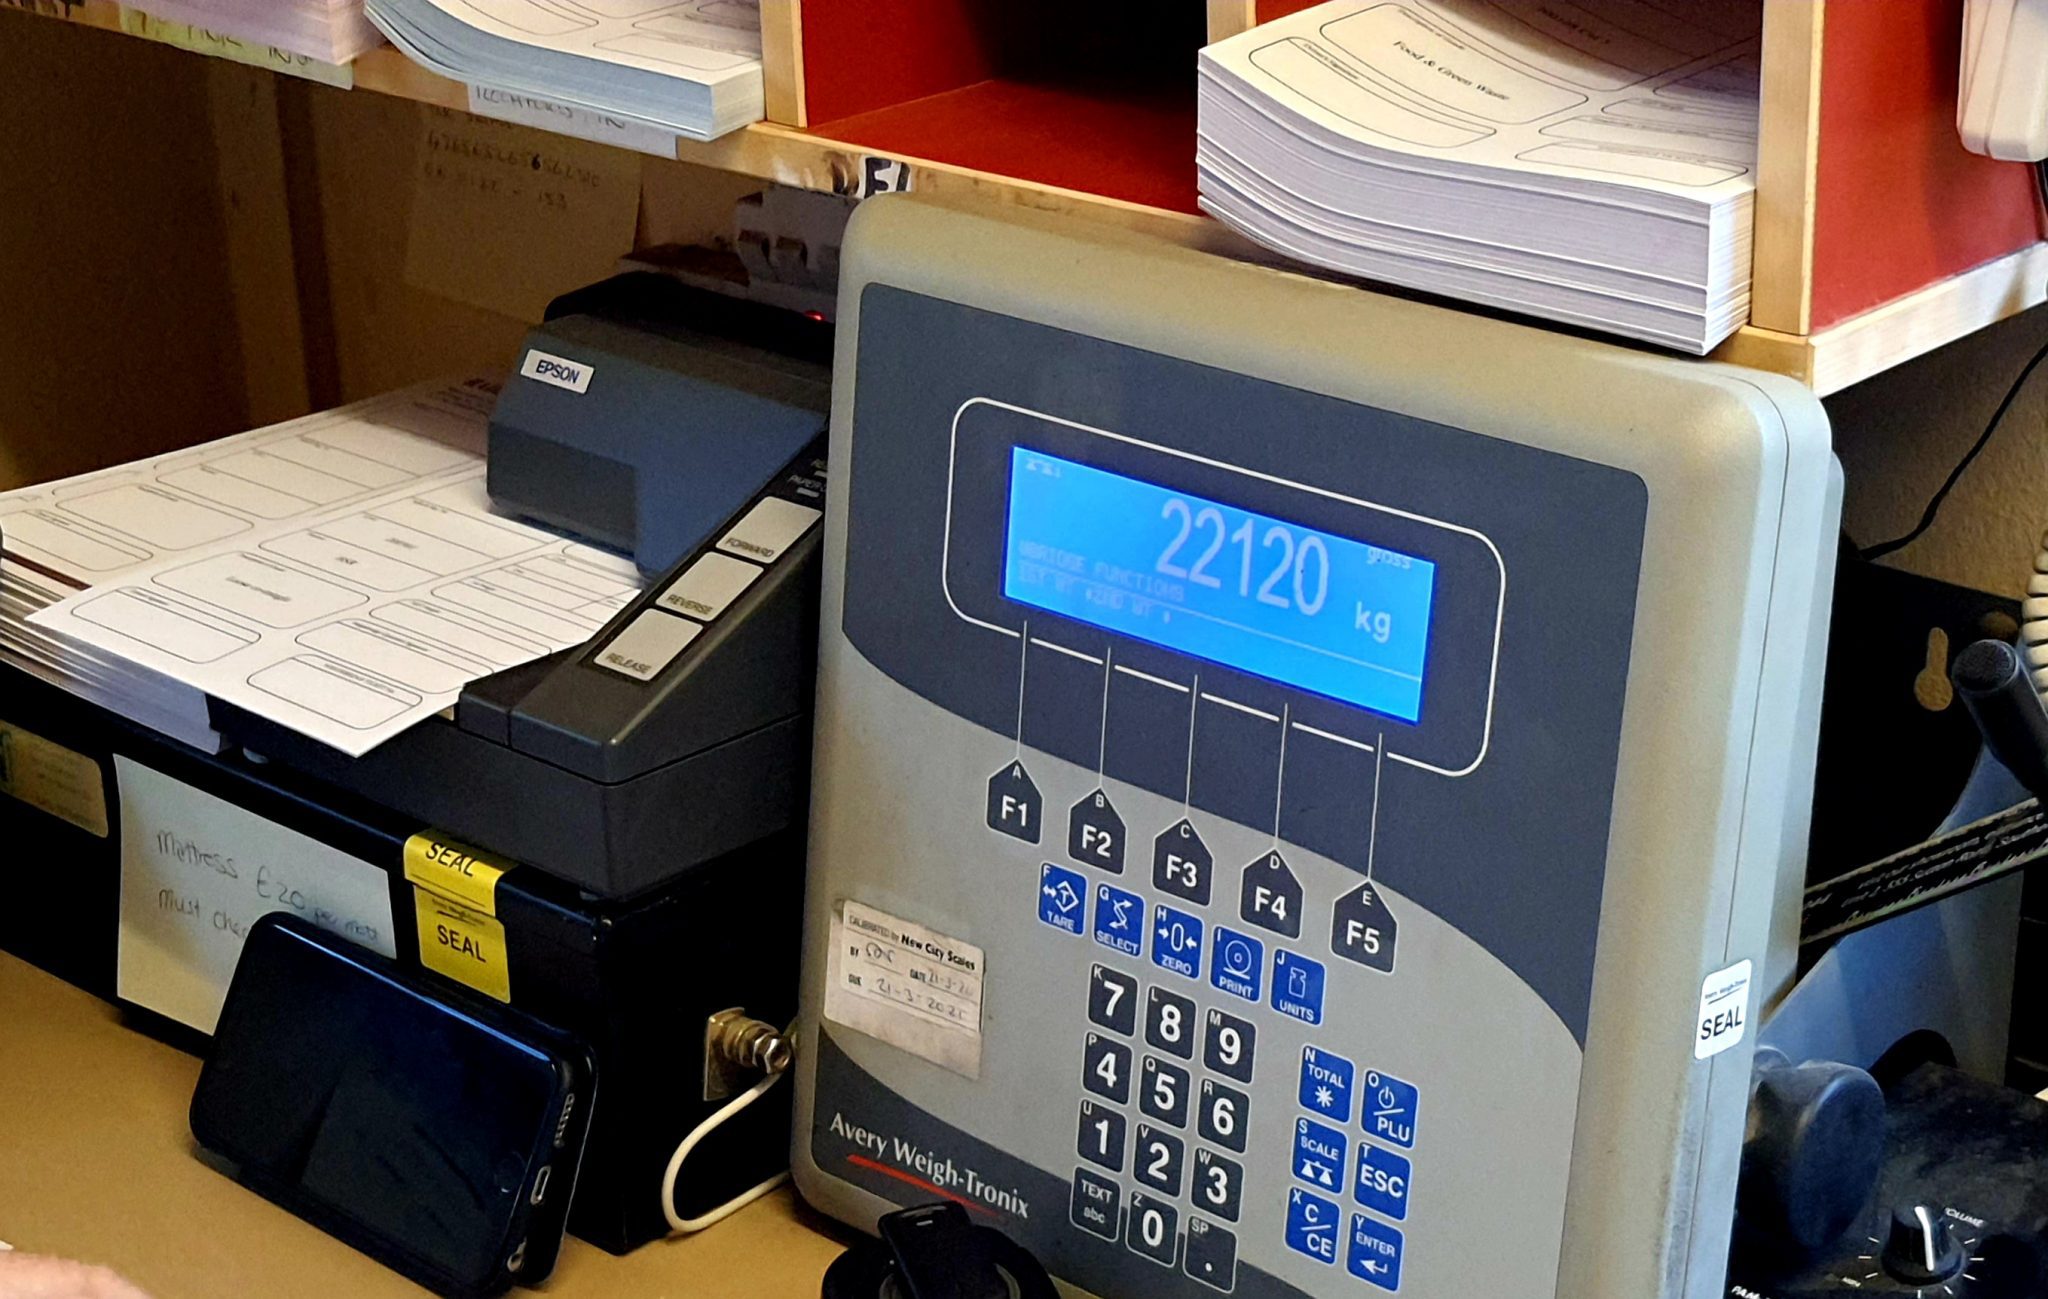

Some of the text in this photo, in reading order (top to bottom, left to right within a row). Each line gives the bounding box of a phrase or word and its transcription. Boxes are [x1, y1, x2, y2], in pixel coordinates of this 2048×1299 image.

[535, 359, 580, 384] EPSON
[725, 537, 775, 558] FORWARD
[1156, 499, 1330, 616] 22120
[1366, 546, 1412, 570] gross
[1094, 562, 1185, 602] FUNCTIONS
[667, 594, 714, 616] REVERSE
[1354, 600, 1392, 644] kg
[605, 652, 652, 675] RELEASE
[1001, 795, 1029, 828] F1
[157, 829, 239, 880] Mattress
[1081, 825, 1113, 859] F2
[424, 841, 477, 878] SEAL
[1166, 855, 1198, 888] F3
[158, 888, 201, 918] Must
[1254, 886, 1287, 921] F4
[1047, 910, 1075, 931] TARE
[1346, 920, 1380, 955] F5
[436, 923, 487, 963] SEAL
[901, 933, 923, 949] New
[925, 943, 945, 961] City
[947, 950, 976, 972] Scales
[1096, 930, 1140, 955] SELECT
[1161, 954, 1193, 976] ZERO
[1103, 981, 1126, 1018] 7
[1218, 975, 1254, 997] PRINT
[1159, 1003, 1182, 1043] 8
[1279, 1000, 1315, 1022] UNITS
[1700, 1005, 1743, 1041] SEAL
[1218, 1026, 1242, 1066] 9
[1096, 1051, 1118, 1089] 4
[1307, 1063, 1346, 1090] TOTAL
[1153, 1072, 1176, 1111] 5
[1212, 1096, 1236, 1136] 6
[1377, 1116, 1411, 1143] PLU
[1094, 1118, 1109, 1156] 1
[1300, 1136, 1340, 1162] SCALE
[829, 1111, 1030, 1219] Avery Weigh-Tronix
[1147, 1142, 1170, 1182] 2
[1080, 1178, 1113, 1203] TEXT
[1205, 1166, 1228, 1205] 3
[1359, 1168, 1405, 1199] ESC
[1083, 1205, 1106, 1224] abc
[1141, 1208, 1164, 1248] 0
[1191, 1219, 1210, 1235] SP
[1355, 1231, 1397, 1259] ENTER
